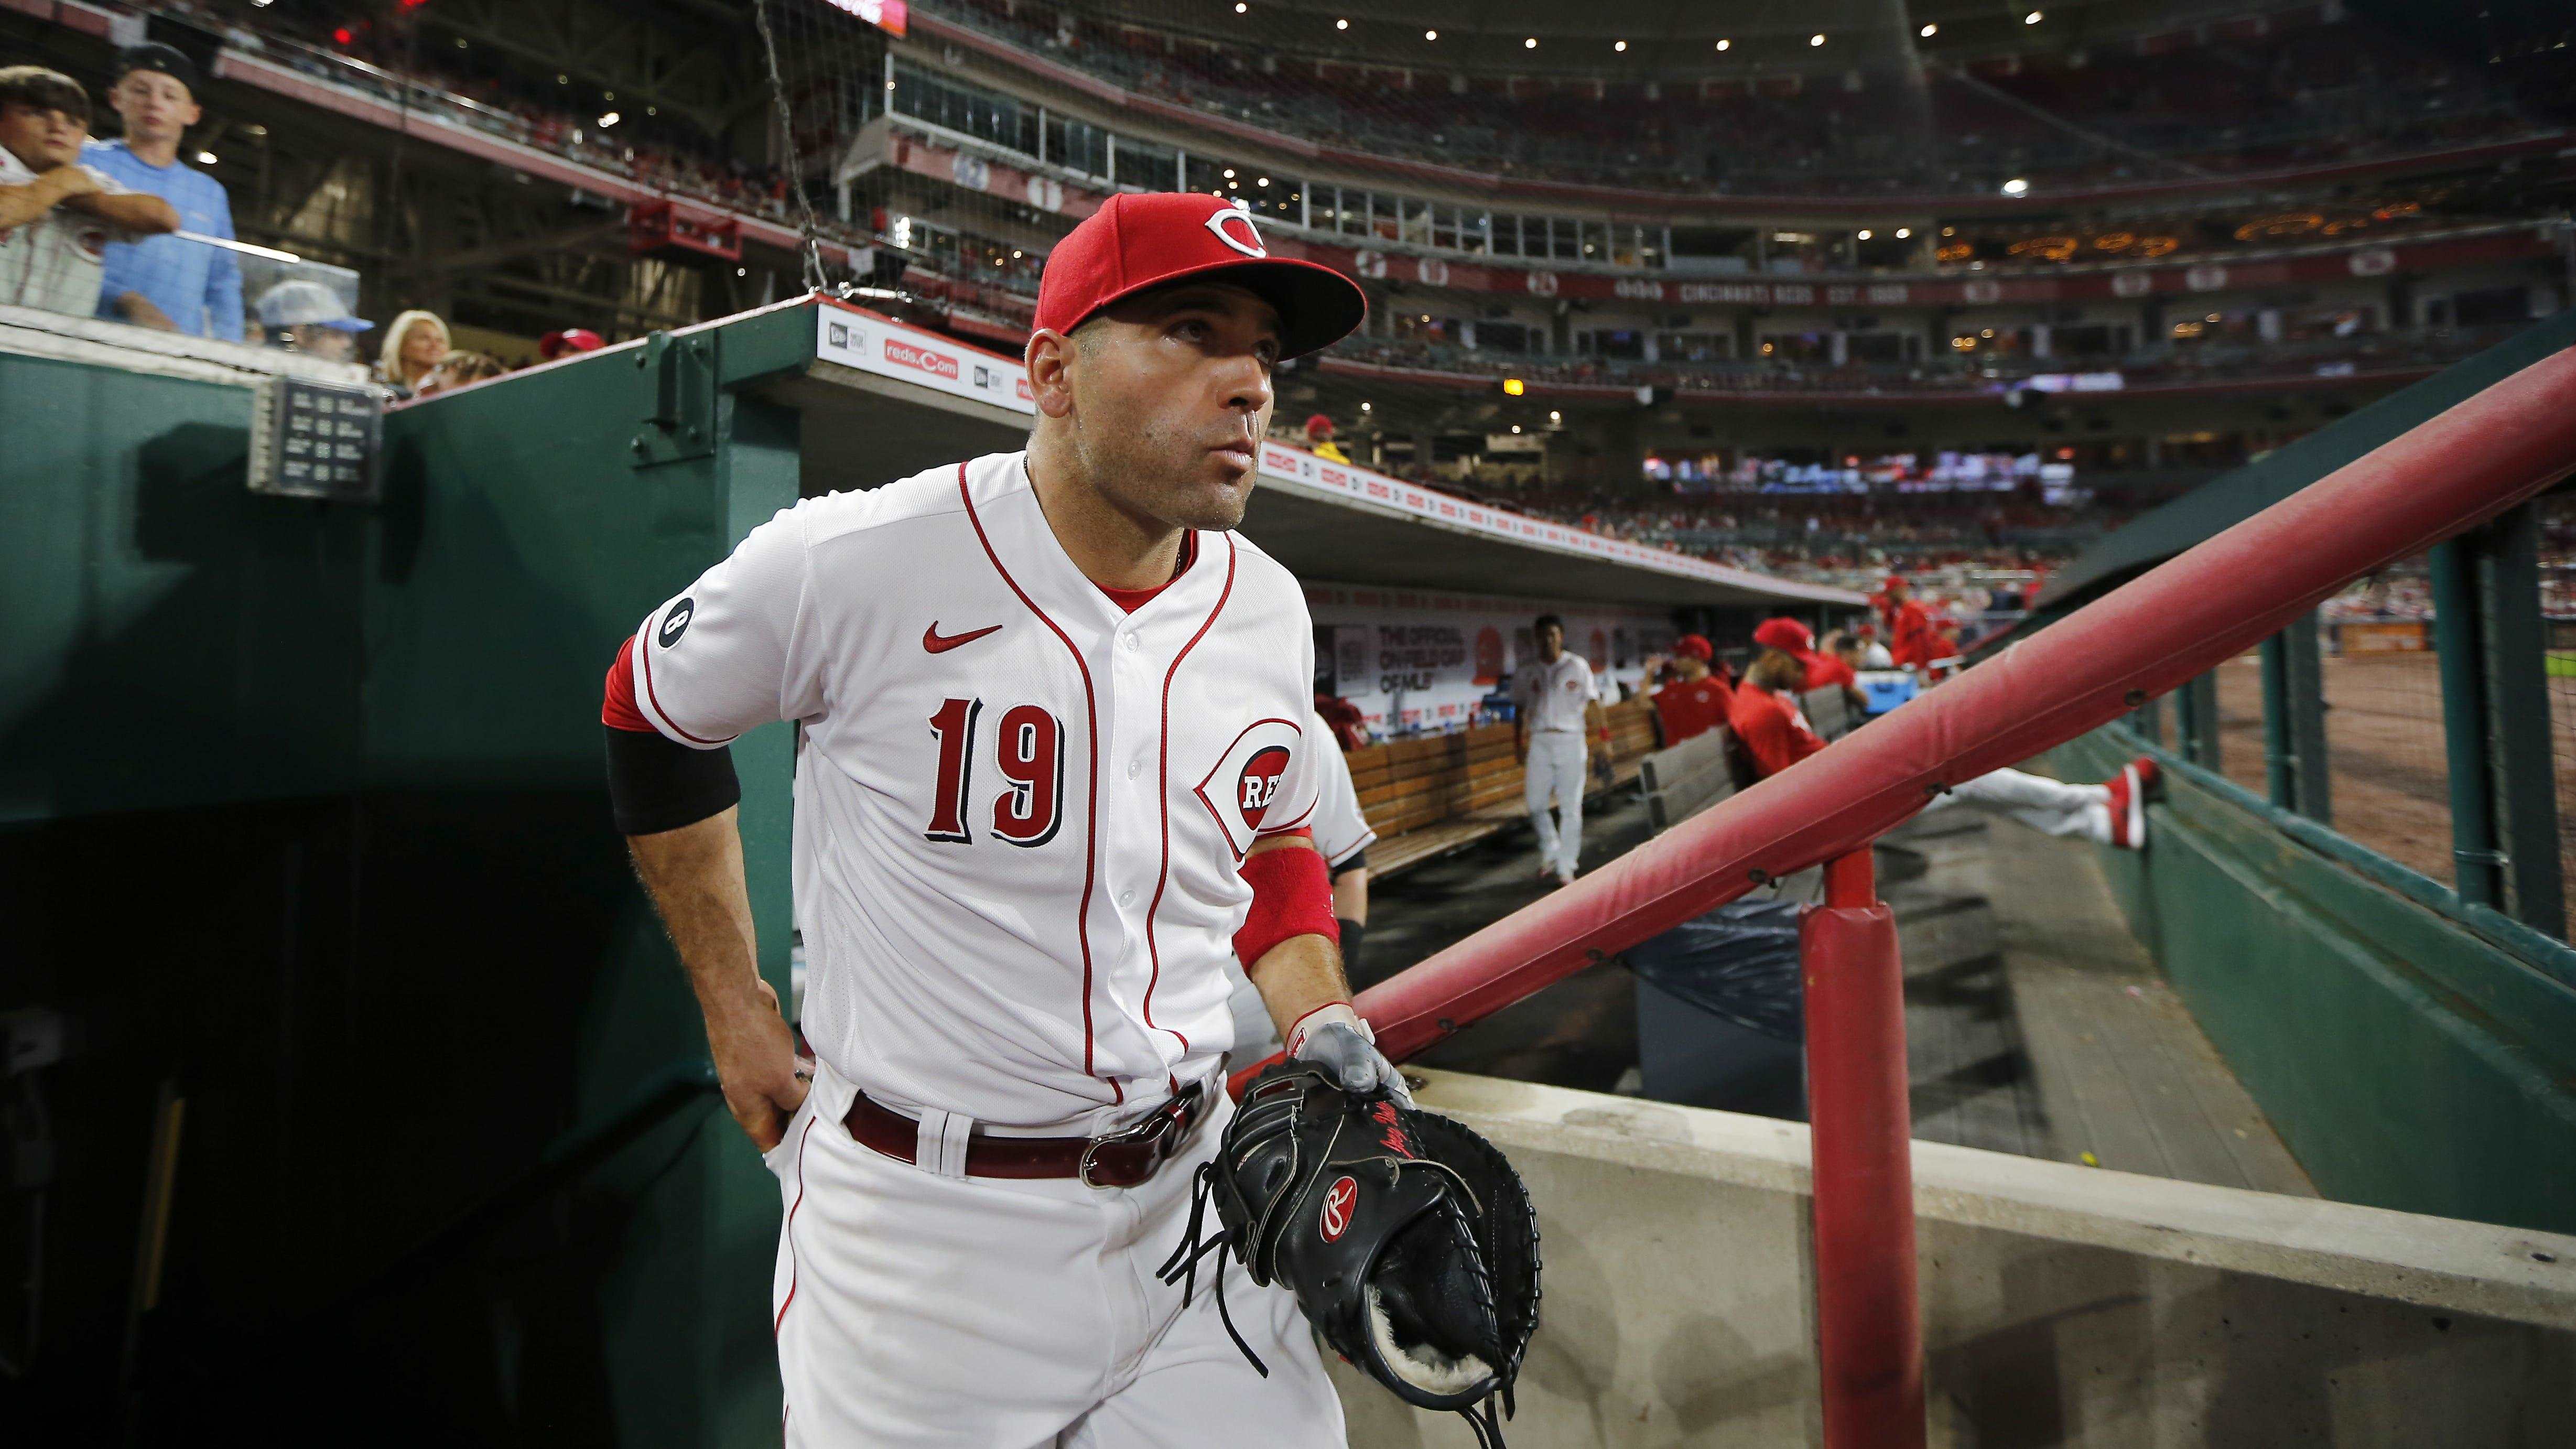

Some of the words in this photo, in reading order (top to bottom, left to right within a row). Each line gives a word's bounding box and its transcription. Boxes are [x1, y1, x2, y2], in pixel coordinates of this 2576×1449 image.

[1205, 208, 1267, 258] C
[664, 610, 689, 635] 8
[923, 696, 1065, 848] 19
[1242, 775, 1281, 811] RE
[1324, 1185, 1354, 1236] R
